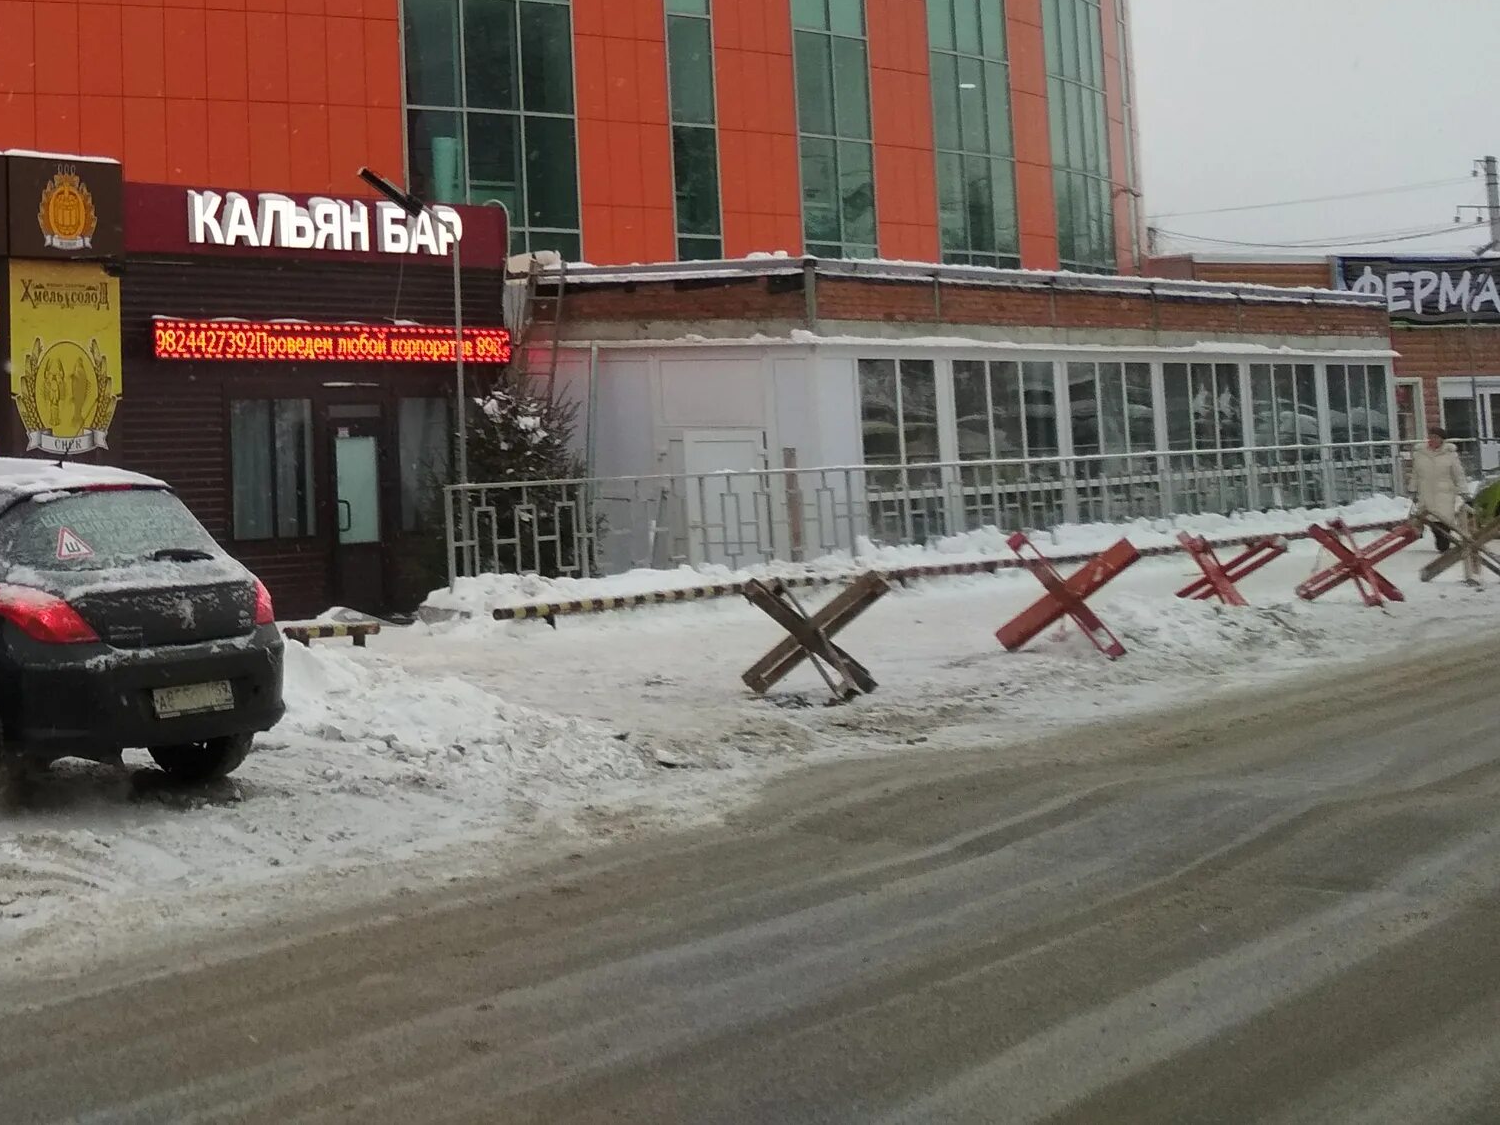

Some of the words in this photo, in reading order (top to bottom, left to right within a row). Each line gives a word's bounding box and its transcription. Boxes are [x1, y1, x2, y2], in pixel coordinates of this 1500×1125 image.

[187, 190, 370, 252] КАЛЬЯН
[375, 200, 463, 256] БАР
[337, 333, 387, 355] любой
